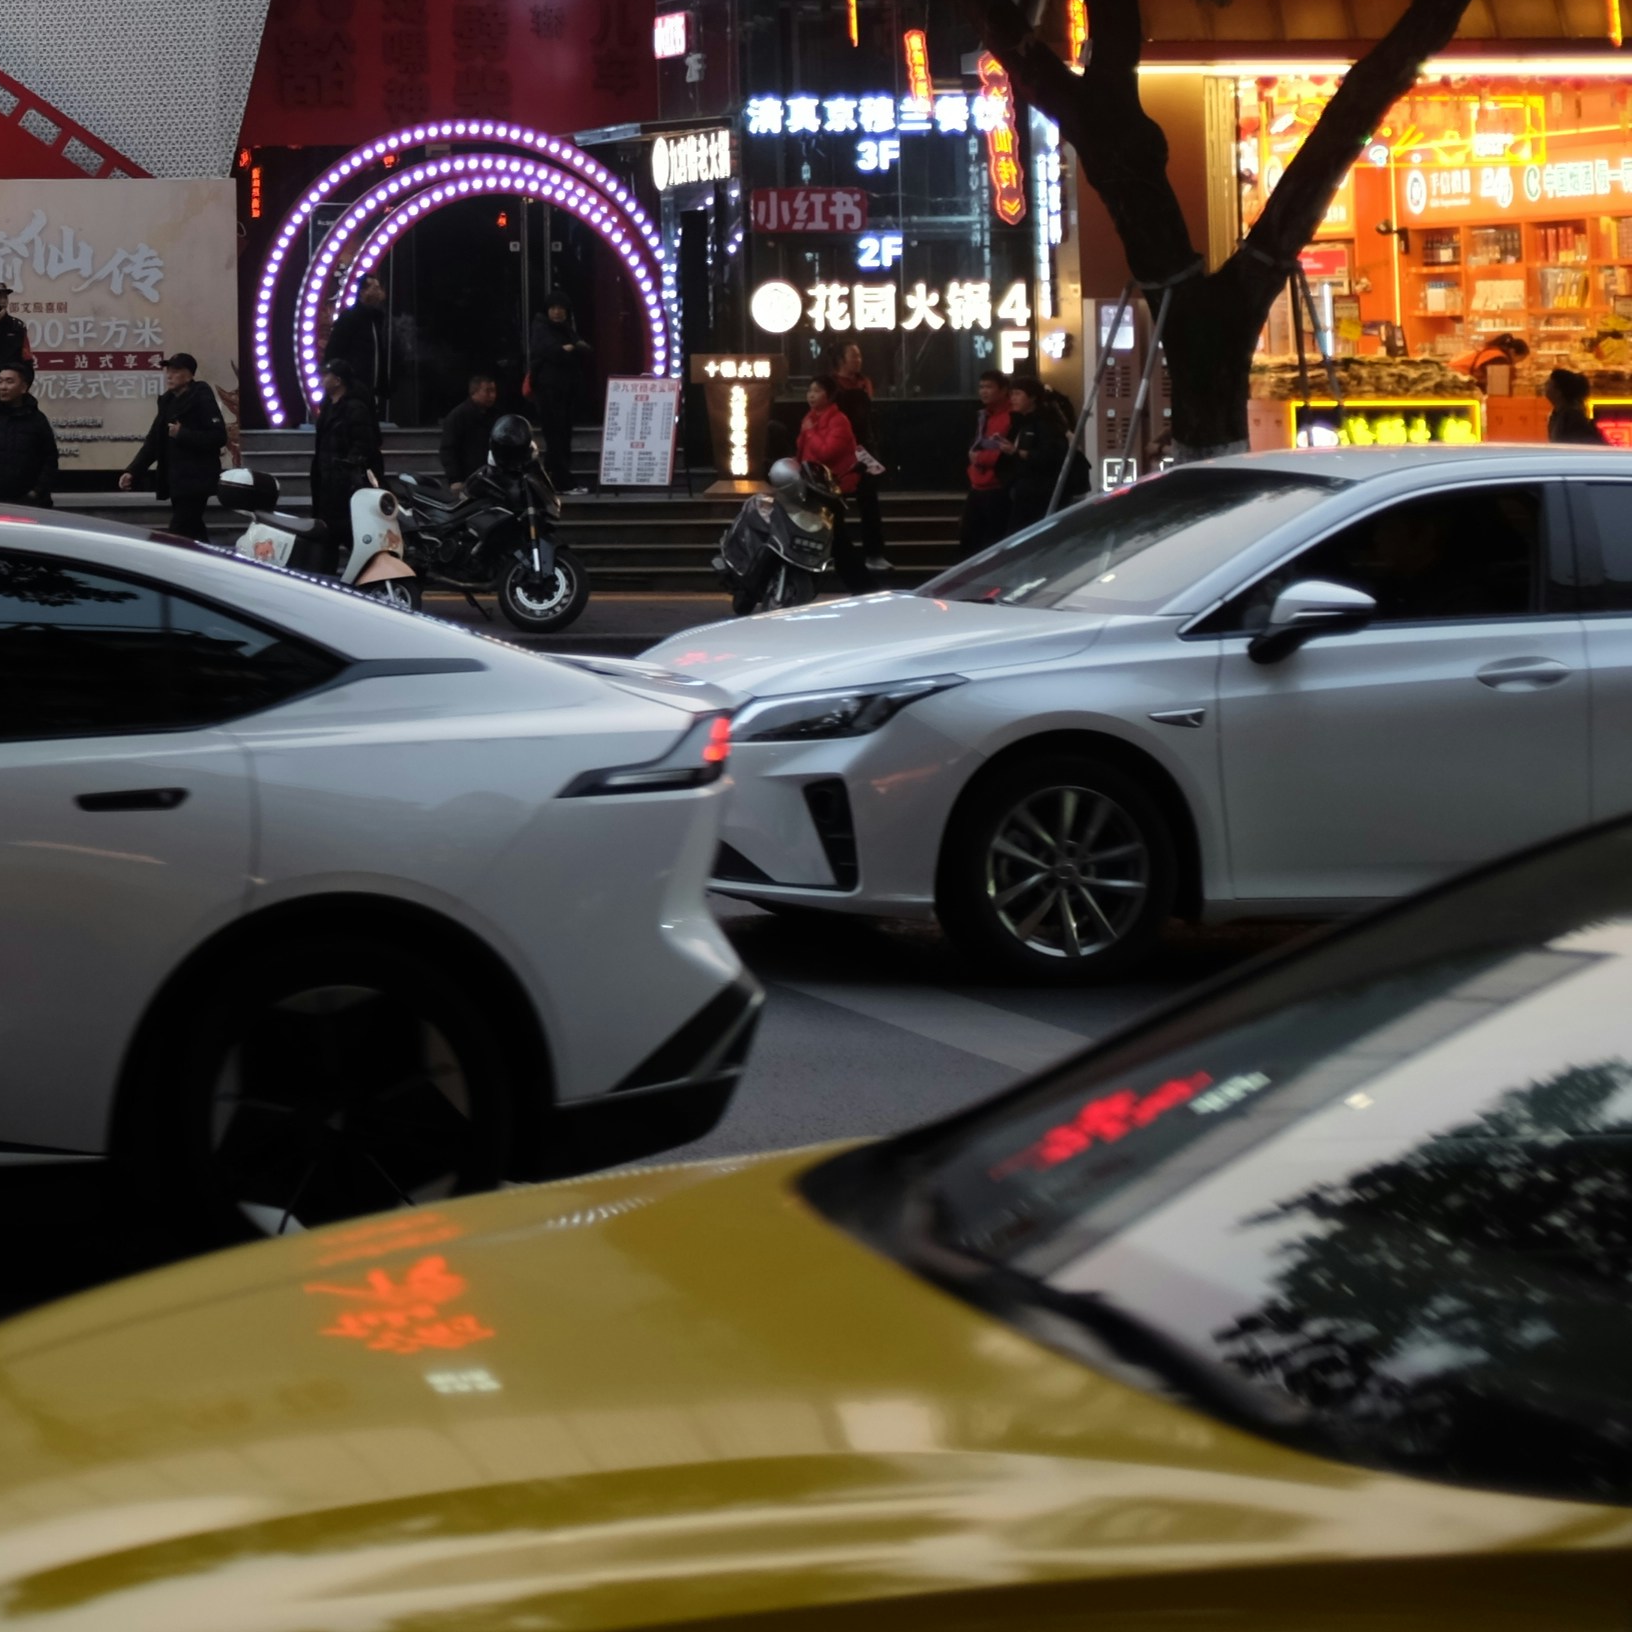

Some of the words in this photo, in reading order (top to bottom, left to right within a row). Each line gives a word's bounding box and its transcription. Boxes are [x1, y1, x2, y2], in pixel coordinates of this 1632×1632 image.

[855, 140, 902, 173] 3F
[756, 191, 864, 231] 小红书
[857, 235, 903, 269] 2F
